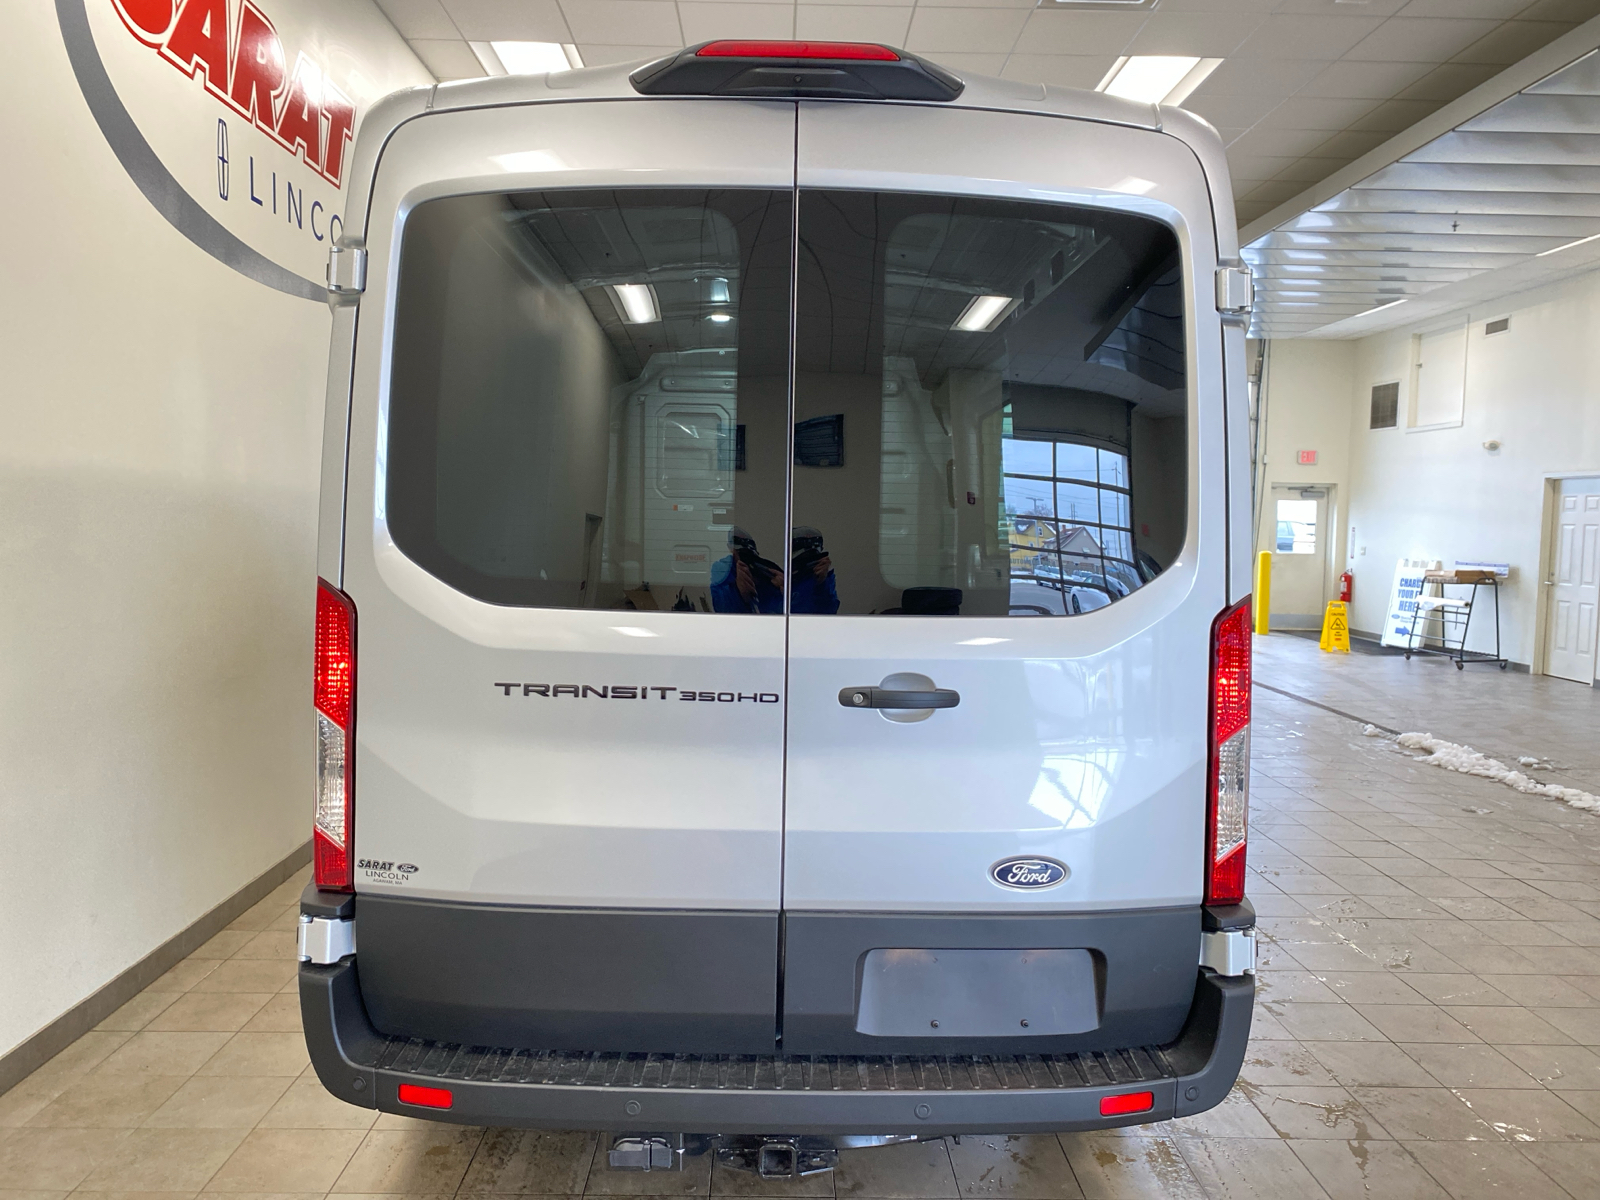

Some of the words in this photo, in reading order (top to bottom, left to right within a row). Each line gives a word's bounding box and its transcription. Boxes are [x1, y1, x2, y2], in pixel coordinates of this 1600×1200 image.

[249, 156, 343, 246] LINCO
[1400, 577, 1422, 589] CHARG
[1397, 588, 1414, 599] YOUR
[494, 682, 677, 700] TRANSIT
[679, 691, 780, 703] 350HD
[357, 859, 394, 871] SARAT
[400, 864, 416, 873] Ford
[1007, 863, 1052, 883] Ford
[365, 870, 409, 880] LINCOLN
